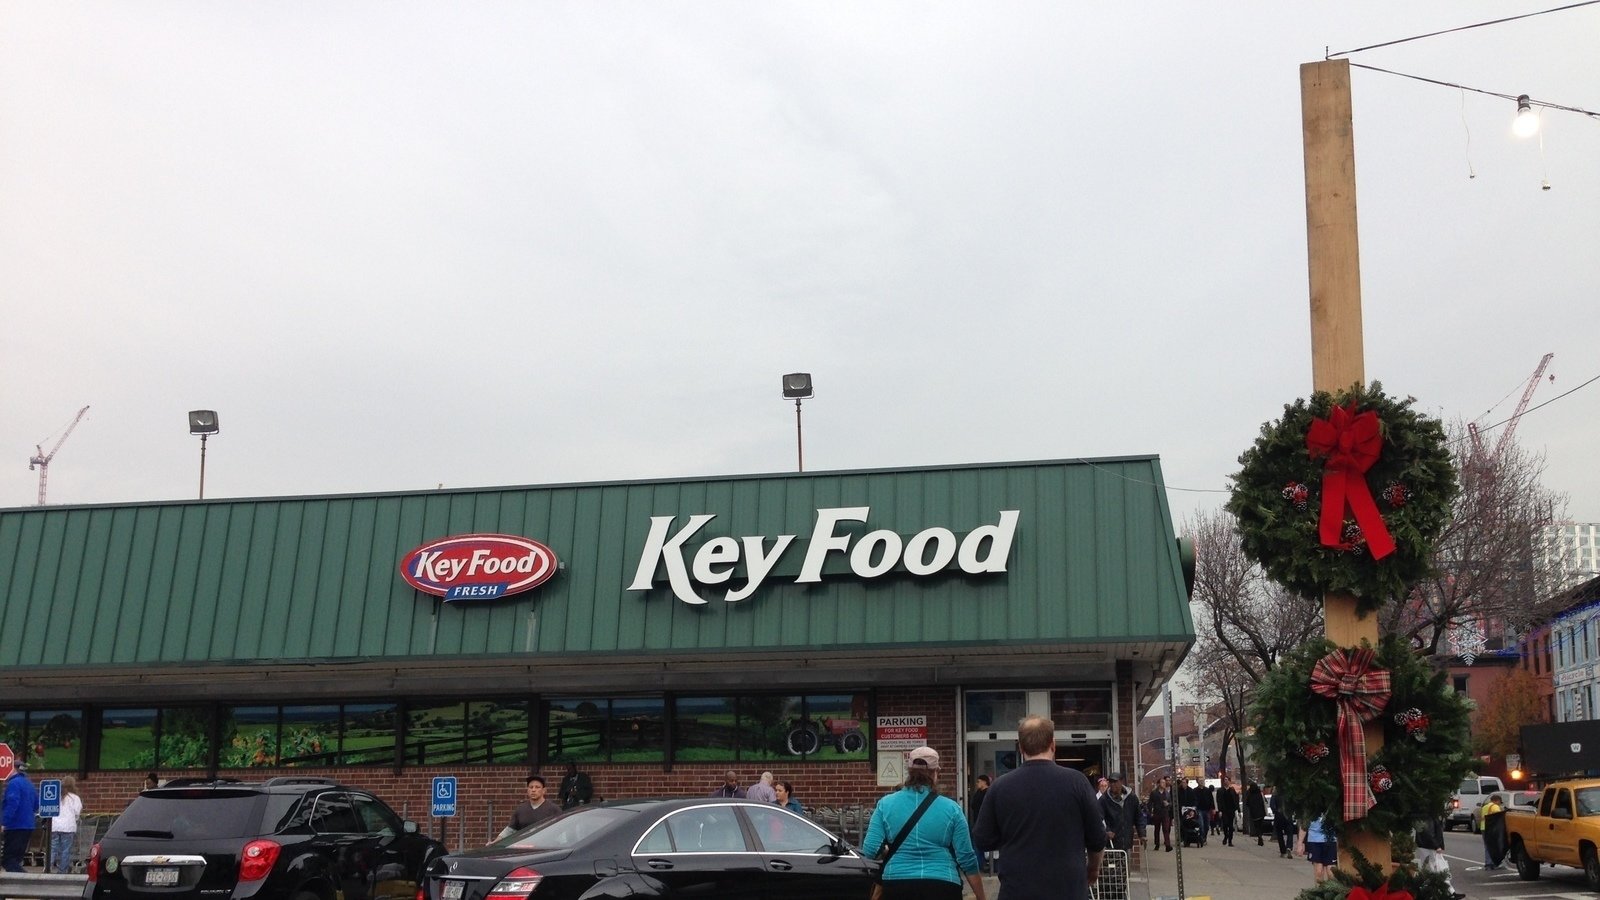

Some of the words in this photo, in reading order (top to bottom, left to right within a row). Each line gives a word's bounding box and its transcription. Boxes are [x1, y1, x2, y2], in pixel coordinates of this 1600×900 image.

[626, 514, 798, 605] Key
[794, 506, 1020, 583] Food
[414, 551, 468, 582] Key
[466, 549, 537, 576] Food
[454, 585, 498, 596] FRESH
[40, 805, 59, 813] PARKING
[434, 803, 455, 811] PARKING
